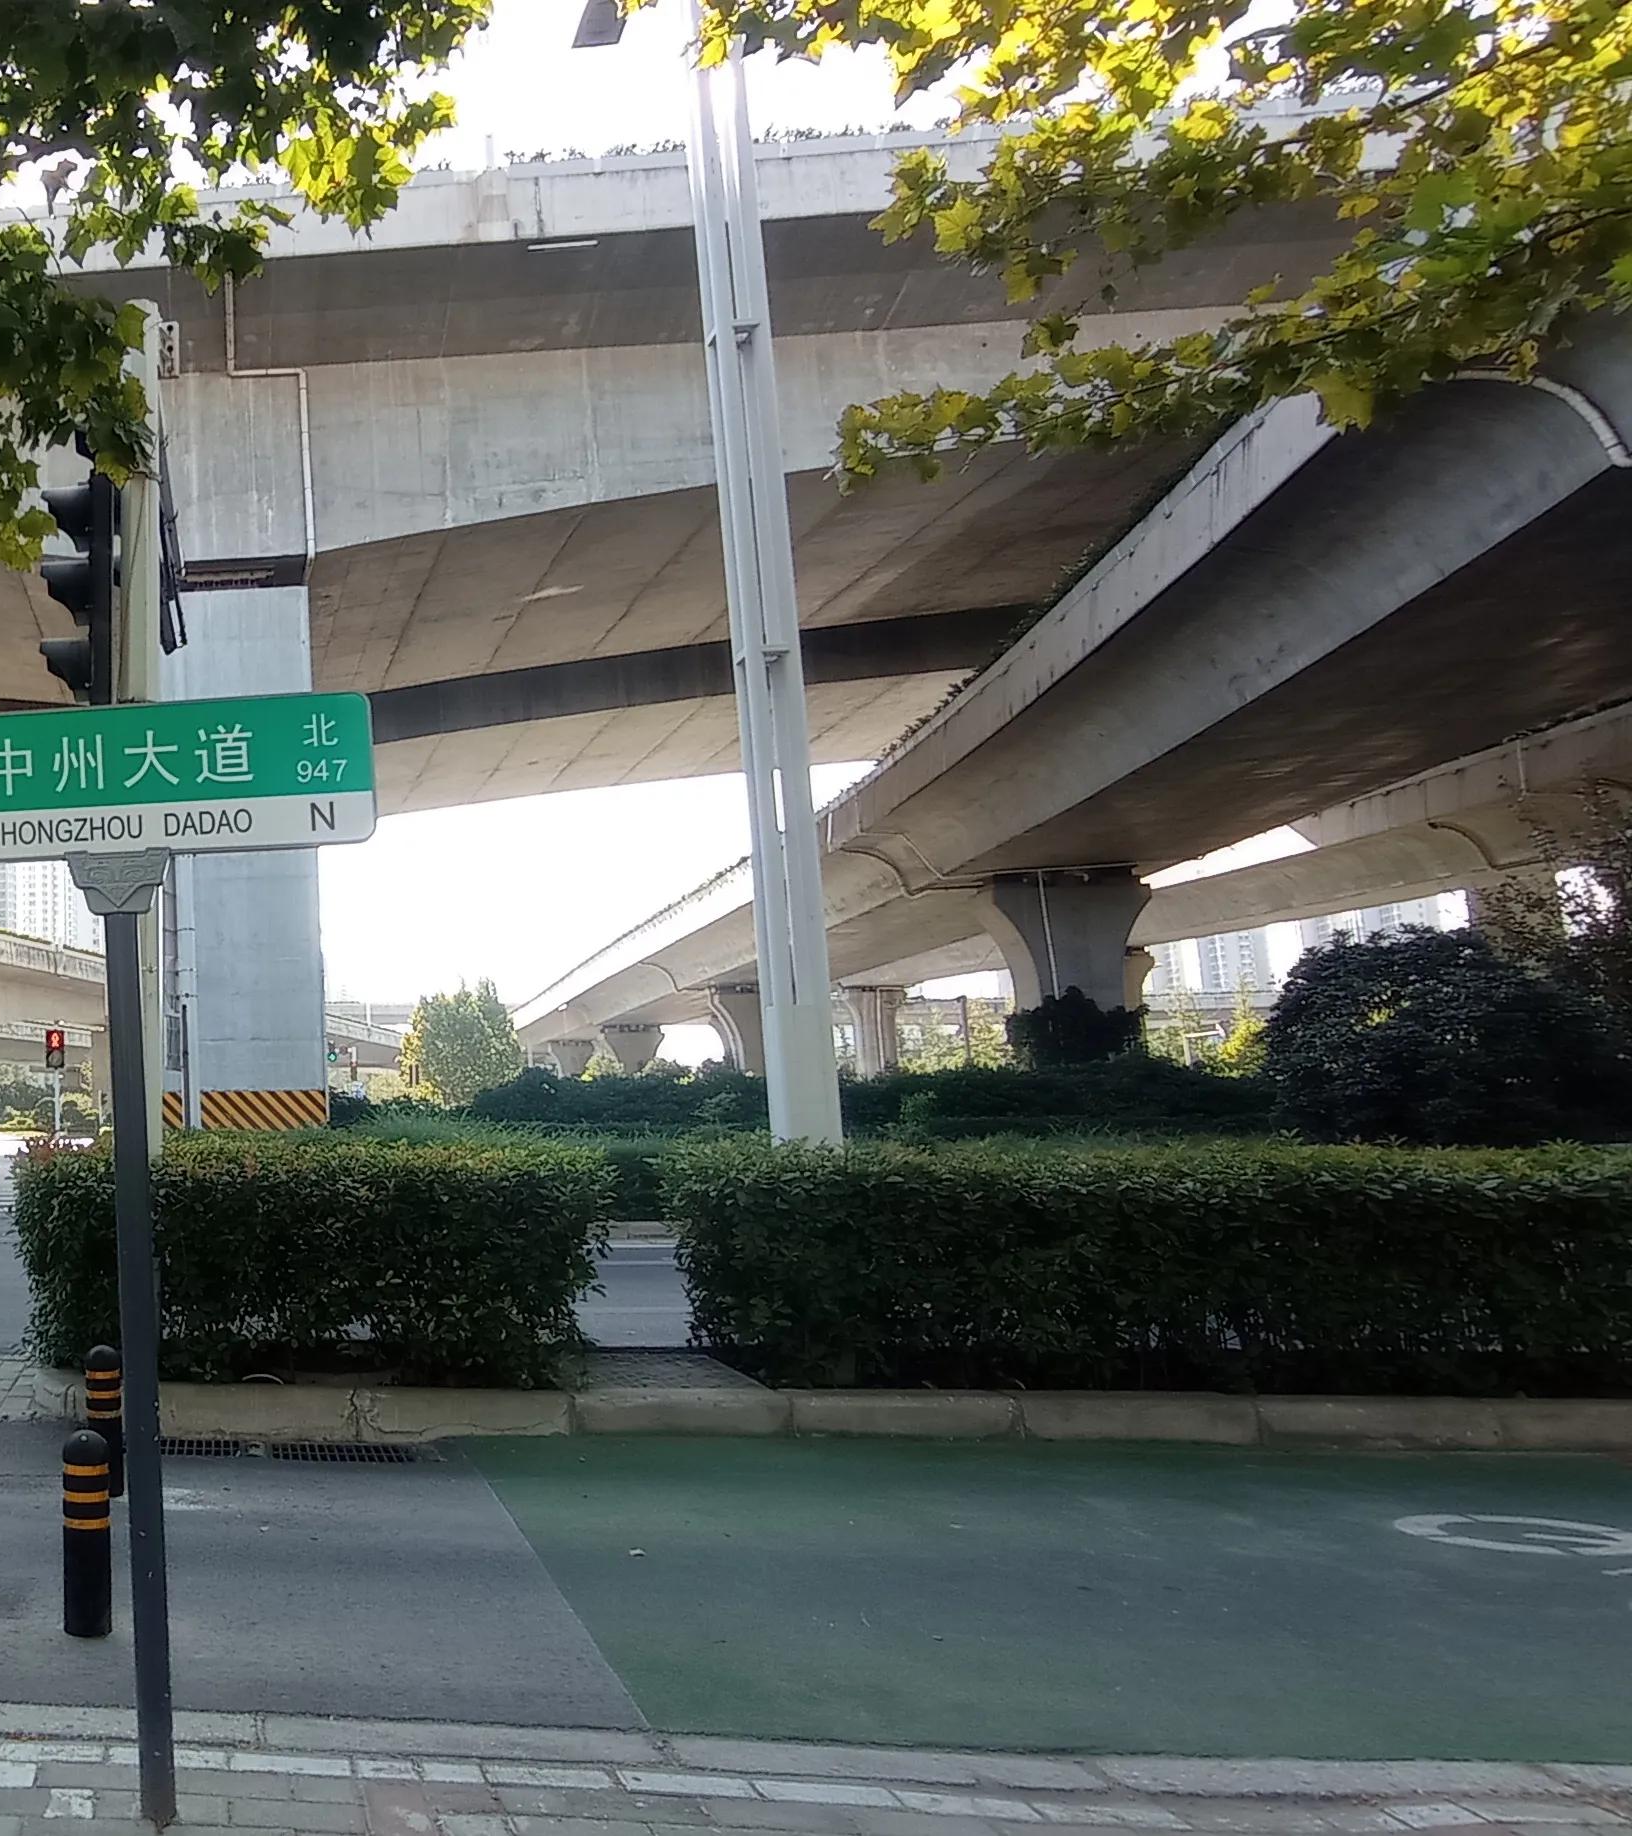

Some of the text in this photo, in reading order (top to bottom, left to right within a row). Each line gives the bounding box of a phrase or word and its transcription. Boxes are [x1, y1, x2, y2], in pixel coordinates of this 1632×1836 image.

[303, 713, 338, 747] 北
[296, 759, 348, 783] 947
[164, 808, 253, 837] DADAO
[309, 801, 336, 831] N
